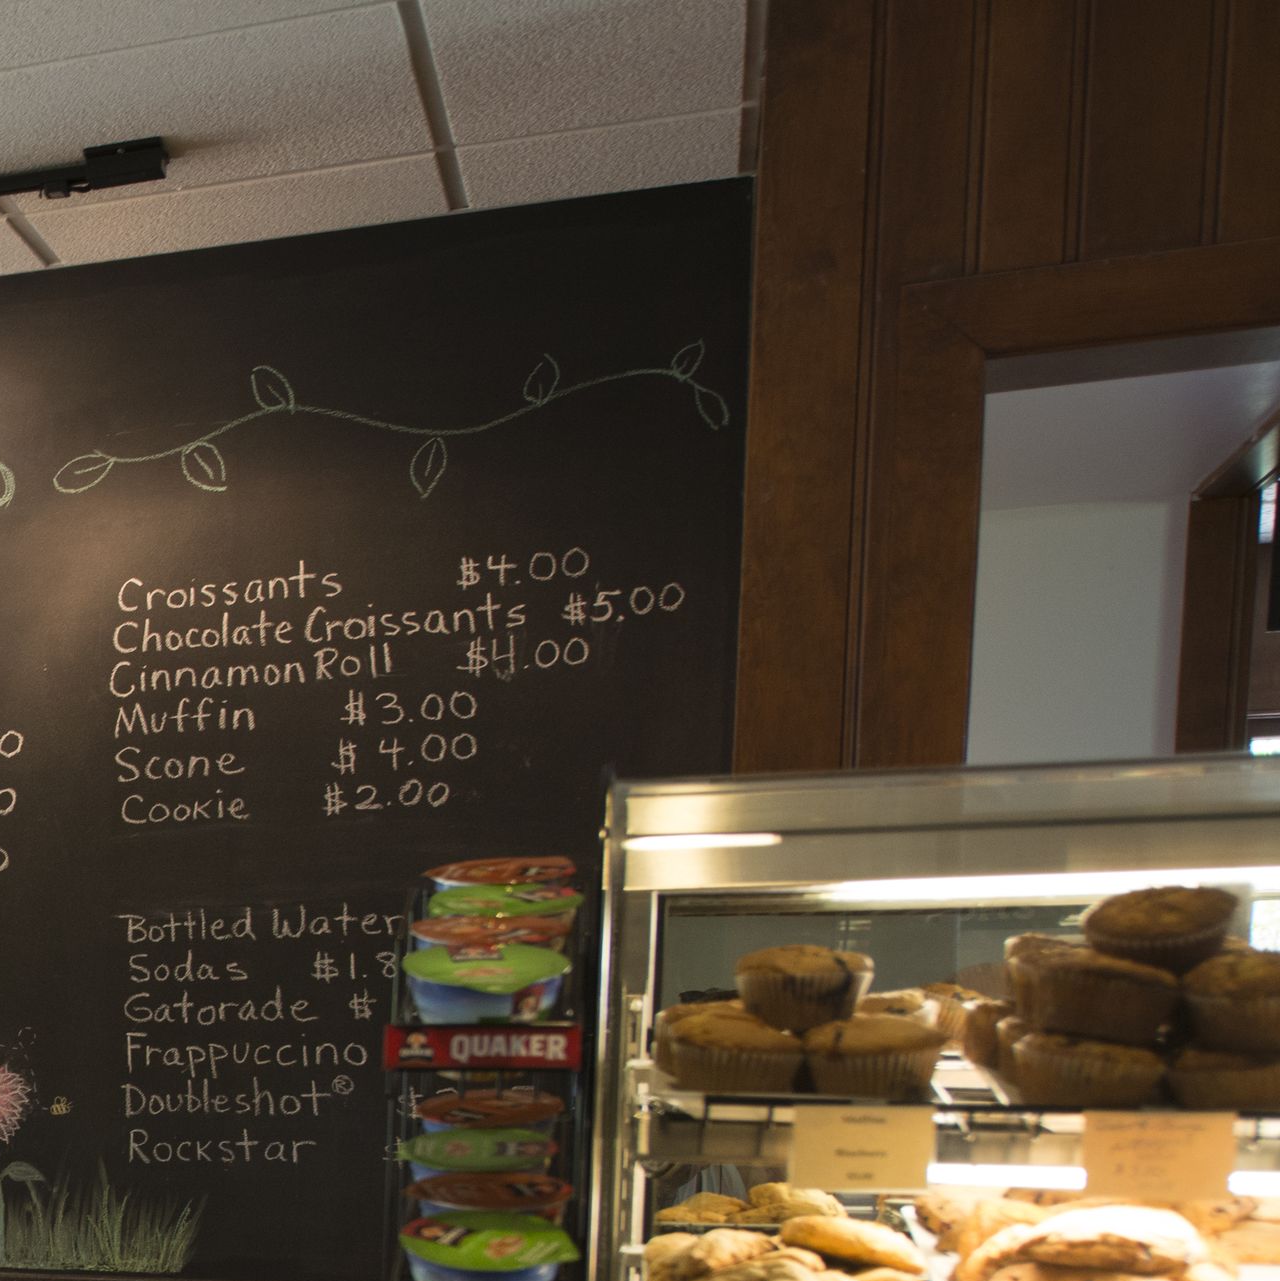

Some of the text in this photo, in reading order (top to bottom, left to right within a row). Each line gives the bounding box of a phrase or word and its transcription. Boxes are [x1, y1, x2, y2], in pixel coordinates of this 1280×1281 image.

[118, 547, 590, 614] Croissants $4.00
[113, 581, 686, 654] Chocolate Croissants $5.00
[109, 636, 590, 698] Cinnamon Roll $4.00
[114, 691, 478, 738] Muffin $3.00
[114, 732, 478, 784] Scone $4.00
[121, 779, 450, 824] Cookie $2.00
[120, 902, 406, 944] Bottled Water
[128, 950, 401, 984] Sodas $1.8
[124, 985, 320, 1026] Gatorade
[125, 1031, 369, 1079] Frappuccino
[448, 1033, 569, 1065] QUAKER
[128, 1127, 318, 1165] Rockstar
